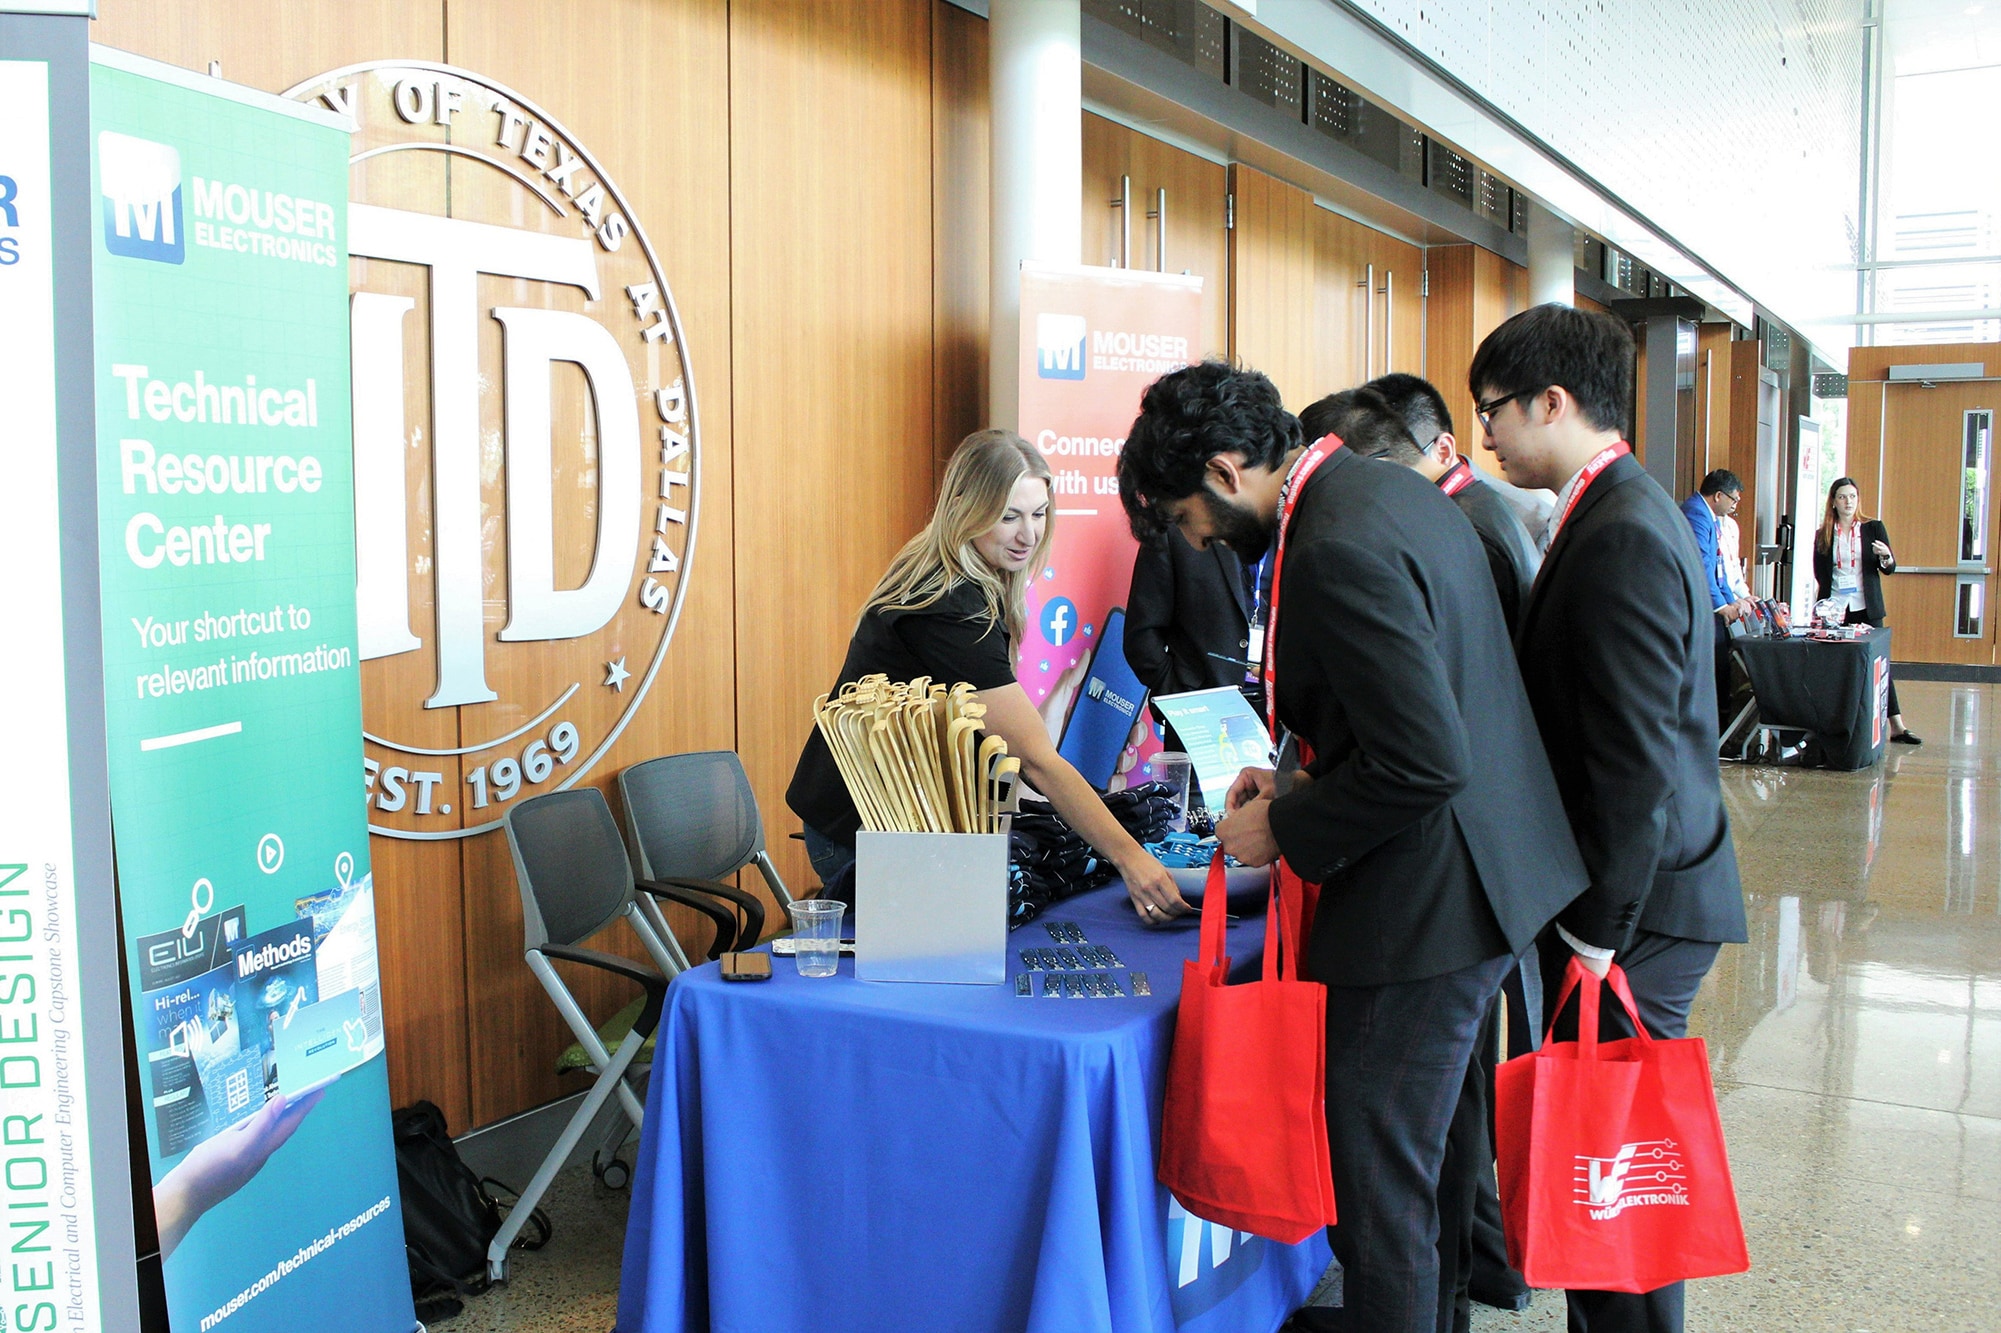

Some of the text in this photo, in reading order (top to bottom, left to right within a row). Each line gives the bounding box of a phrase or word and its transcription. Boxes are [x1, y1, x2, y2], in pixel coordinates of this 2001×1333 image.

[192, 175, 336, 242] MOUSER
[194, 220, 338, 268] ELECTRONICS
[393, 79, 689, 615] OF TEXAS AT DALLAS
[1092, 330, 1188, 360] MOUSER
[112, 363, 318, 428] Technical
[119, 438, 323, 495] Resource
[1037, 429, 1127, 457] Connec
[125, 511, 271, 569] Center
[131, 604, 311, 648] Your shortcut to
[136, 643, 351, 699] relevant information
[1105, 689, 1135, 711] MOUSER
[1103, 697, 1132, 717] ELECTRONICS
[1167, 705, 1210, 718] Play it smart
[467, 721, 580, 809] 1969
[43, 862, 61, 943] Showcase
[238, 933, 312, 978] Methods
[48, 947, 69, 1024] Capstone
[0, 863, 57, 1333] SENIOR DESIGN
[51, 1029, 75, 1127] Engineering
[59, 1130, 79, 1209] Computer
[60, 1213, 80, 1244] and
[63, 1248, 84, 1321] Electrical
[200, 1195, 391, 1333] mouser.com/technical-resources
